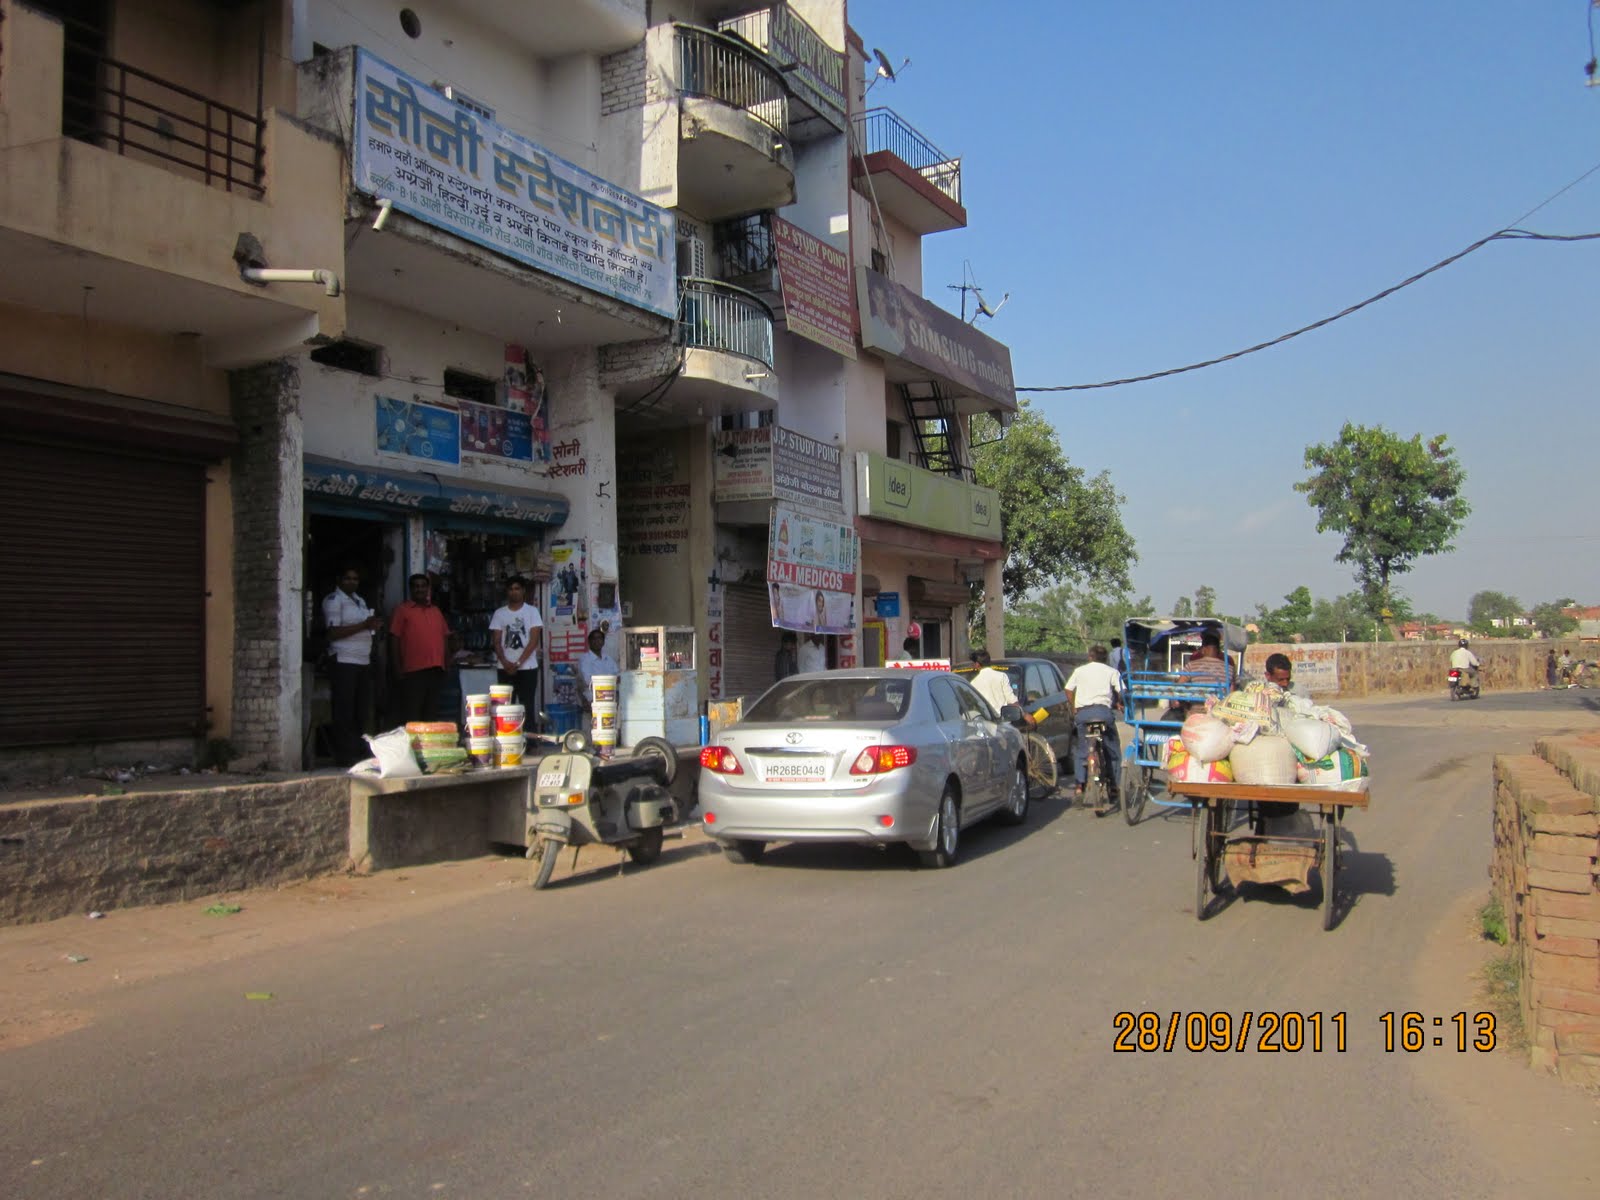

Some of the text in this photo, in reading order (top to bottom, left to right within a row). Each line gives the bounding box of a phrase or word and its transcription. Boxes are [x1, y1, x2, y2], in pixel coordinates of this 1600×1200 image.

[789, 15, 817, 72] STUDY
[817, 42, 845, 93] POINT
[368, 136, 392, 158] हमारे
[365, 74, 669, 264] सोनी स्टेशनरी
[776, 221, 791, 240] J.P.
[793, 229, 820, 255] STUDY
[822, 246, 847, 270] POINT
[908, 318, 977, 375] SAMSUNG
[977, 359, 1011, 391] mobile
[553, 438, 581, 460] सोनी
[754, 427, 771, 443] POIN
[773, 427, 788, 447] J.P.
[789, 434, 816, 458] STUDY
[817, 443, 840, 464] POINT
[549, 458, 586, 480] स्टेशनरी
[888, 476, 906, 496] idea
[449, 494, 552, 523] सोनी स्टेशनरी
[770, 561, 843, 590] RAJ MEDICOS
[766, 765, 825, 776] HR26BE0449
